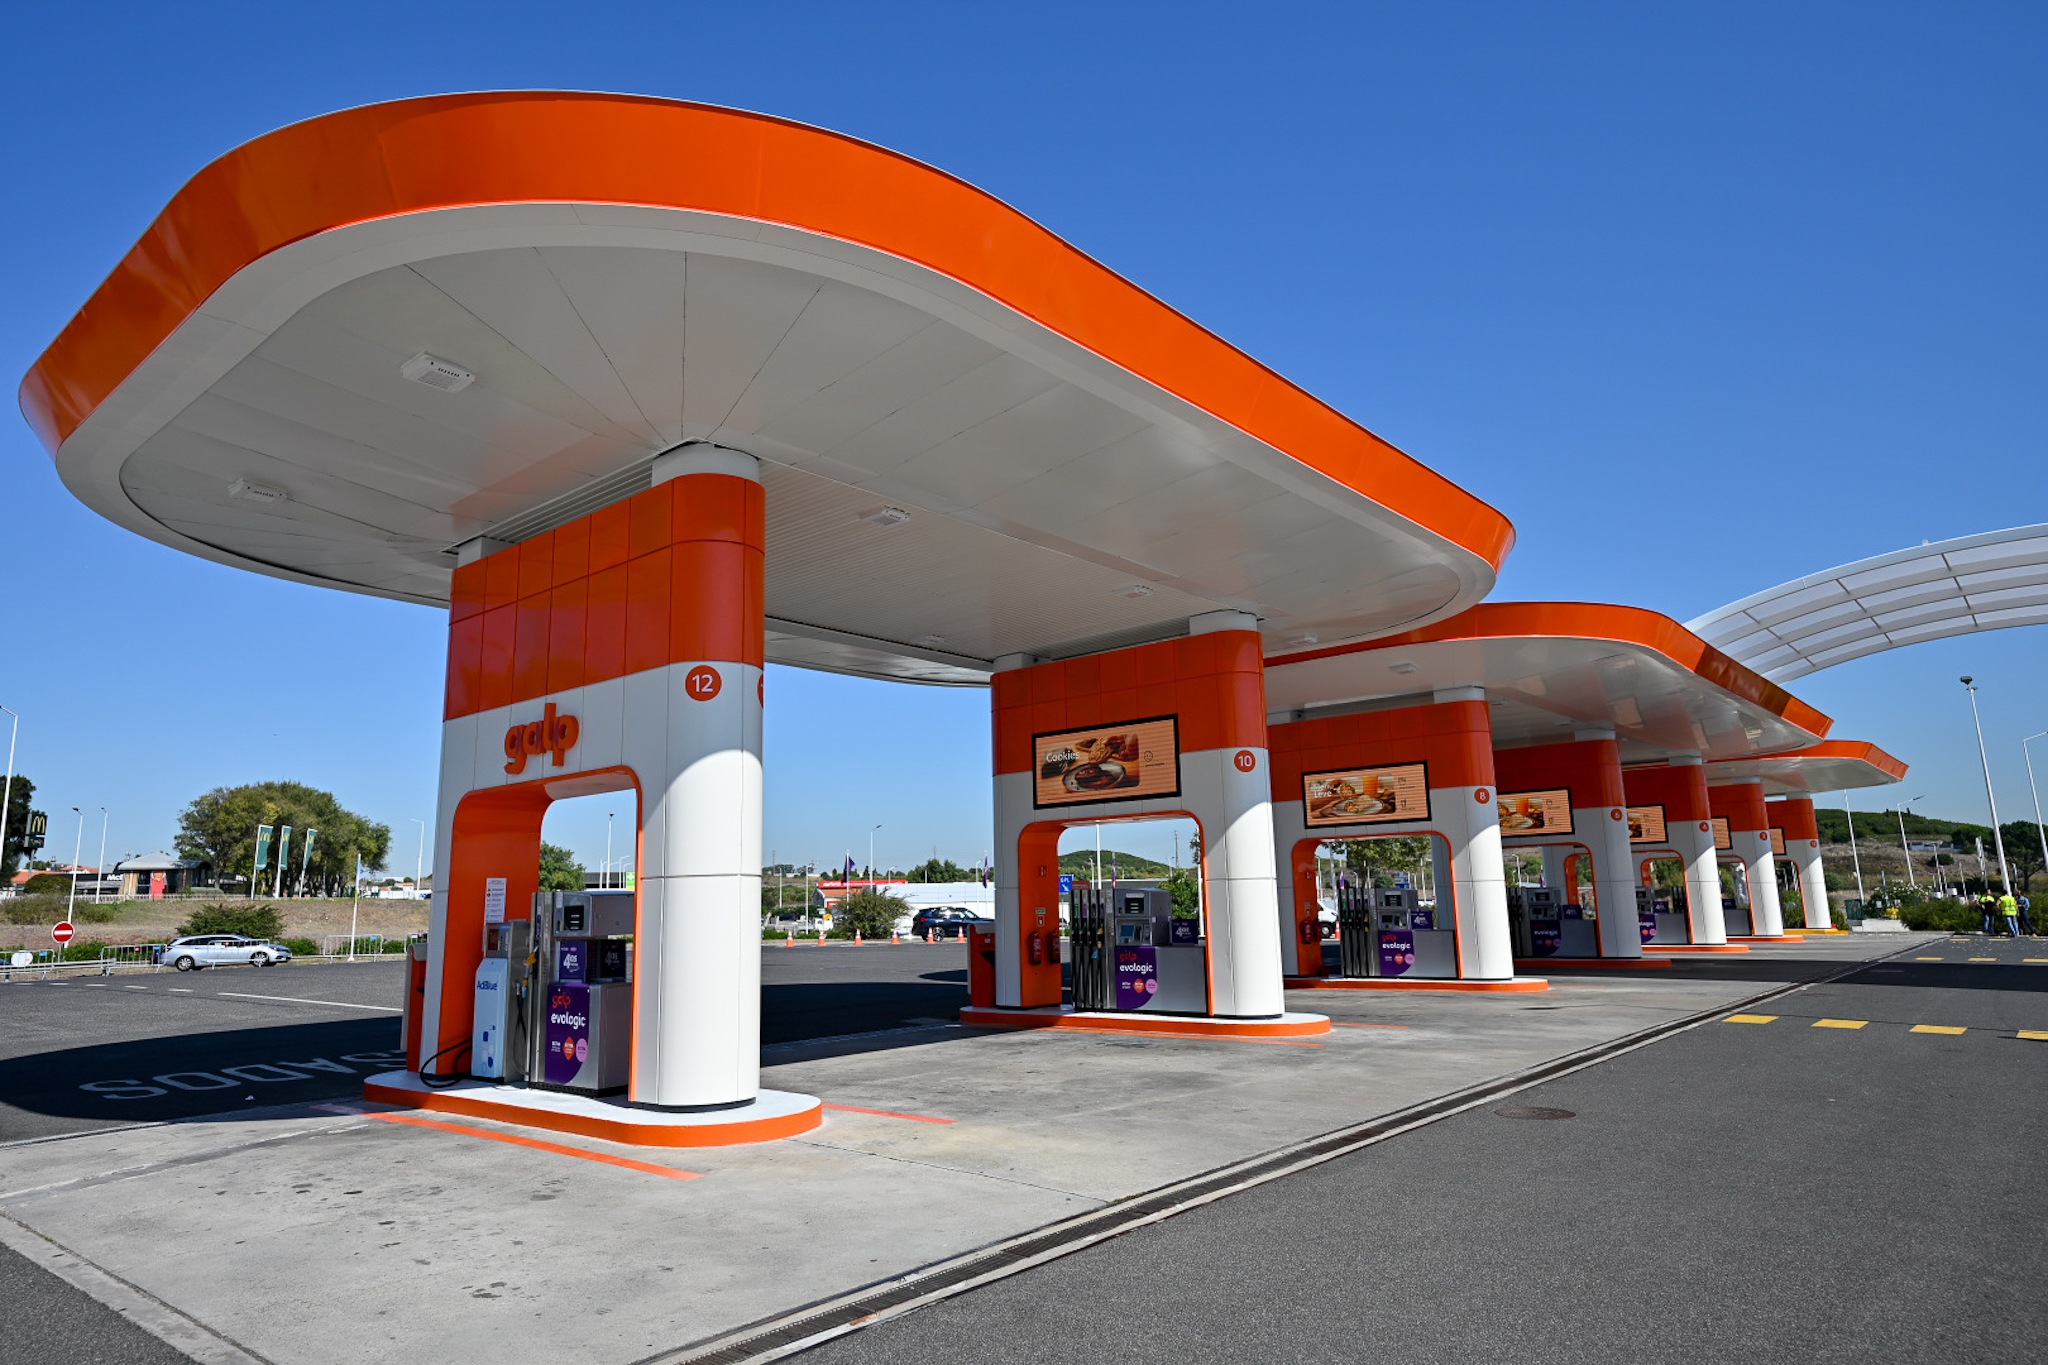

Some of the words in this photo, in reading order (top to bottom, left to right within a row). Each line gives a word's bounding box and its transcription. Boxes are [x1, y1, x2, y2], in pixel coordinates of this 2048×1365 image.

[692, 674, 714, 692] 12
[504, 702, 580, 775] galp
[1046, 750, 1080, 763] Cookies
[1238, 755, 1253, 767] 10
[1479, 791, 1487, 801] 8
[563, 953, 571, 969] 4
[1119, 962, 1154, 975] evologic
[476, 980, 498, 991] AdBlue
[552, 991, 572, 1009] galp
[550, 1011, 587, 1030] evologic
